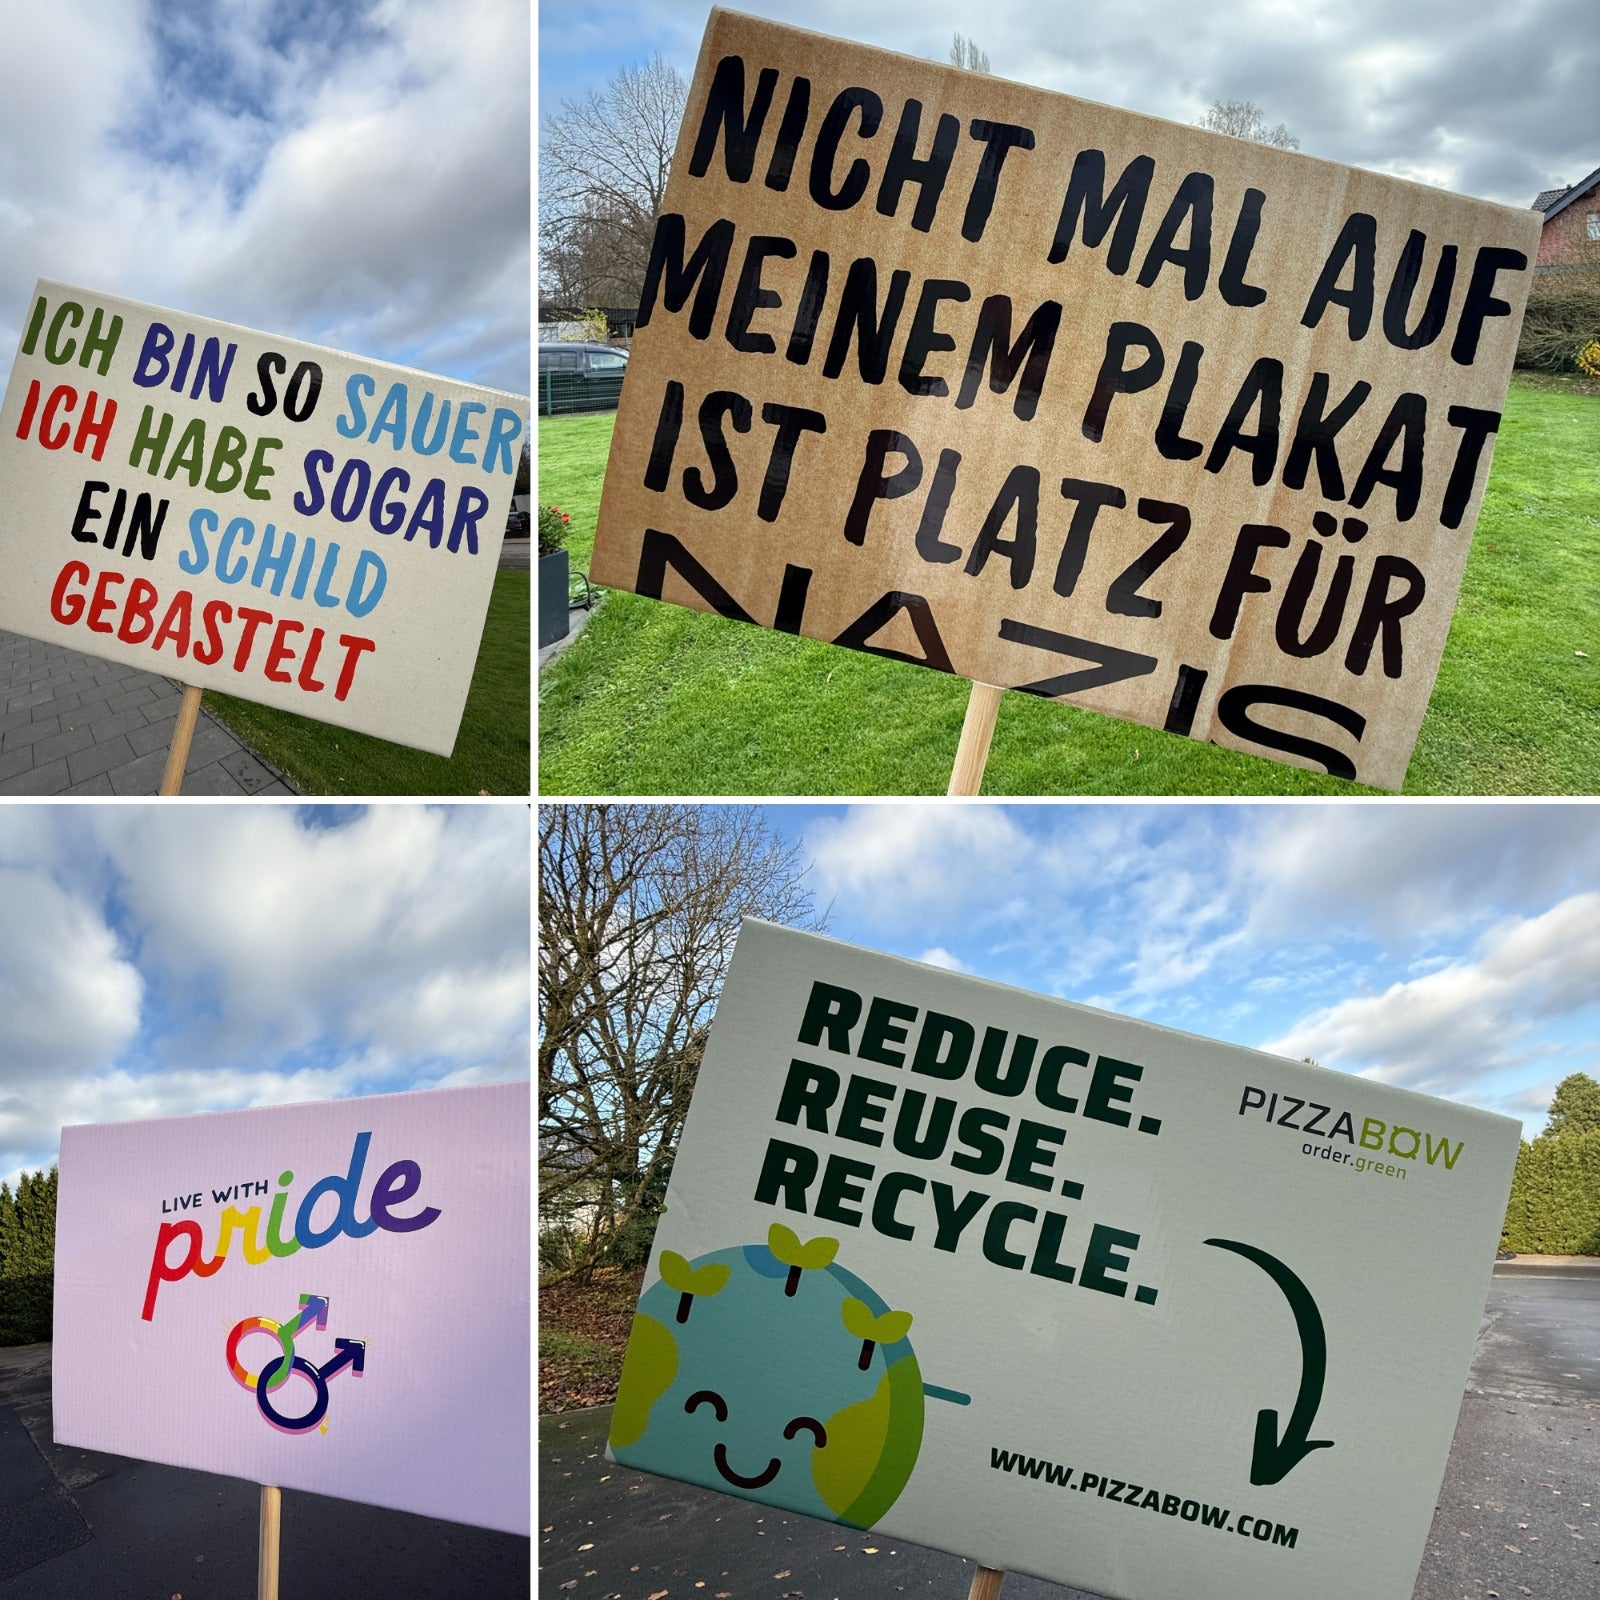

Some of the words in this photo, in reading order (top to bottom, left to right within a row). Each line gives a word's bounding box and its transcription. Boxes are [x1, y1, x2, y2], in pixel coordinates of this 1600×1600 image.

[688, 55, 1035, 242] NICHT
[1047, 149, 1266, 307] MAL
[1301, 213, 1527, 366] AUF
[21, 297, 123, 376] ICH
[133, 323, 238, 402] BIN
[247, 352, 323, 422] SO
[336, 374, 522, 475] SAUER
[635, 213, 1062, 421] MEINEM
[1082, 322, 1502, 529] PLAKAT
[16, 380, 117, 461] ICH
[129, 405, 283, 501] HABE
[294, 449, 489, 554] SOGAR
[643, 380, 826, 522] IST
[844, 430, 1191, 618] PLATZ
[1209, 511, 1425, 678] FÜR
[71, 480, 169, 560] EIN
[178, 508, 387, 618] SCHILD
[50, 560, 375, 702] GEBASTELT
[775, 1058, 1084, 1200] REUSE.
[797, 981, 1162, 1136] REDUCE.
[141, 1131, 442, 1322] pride
[162, 1192, 203, 1214] LIVE
[212, 1179, 269, 1202] WITH
[754, 1138, 1158, 1306] RECYCLE.
[1302, 1143, 1407, 1180] order.green
[990, 1447, 1299, 1549] WWW.PIZZABOW.COM
